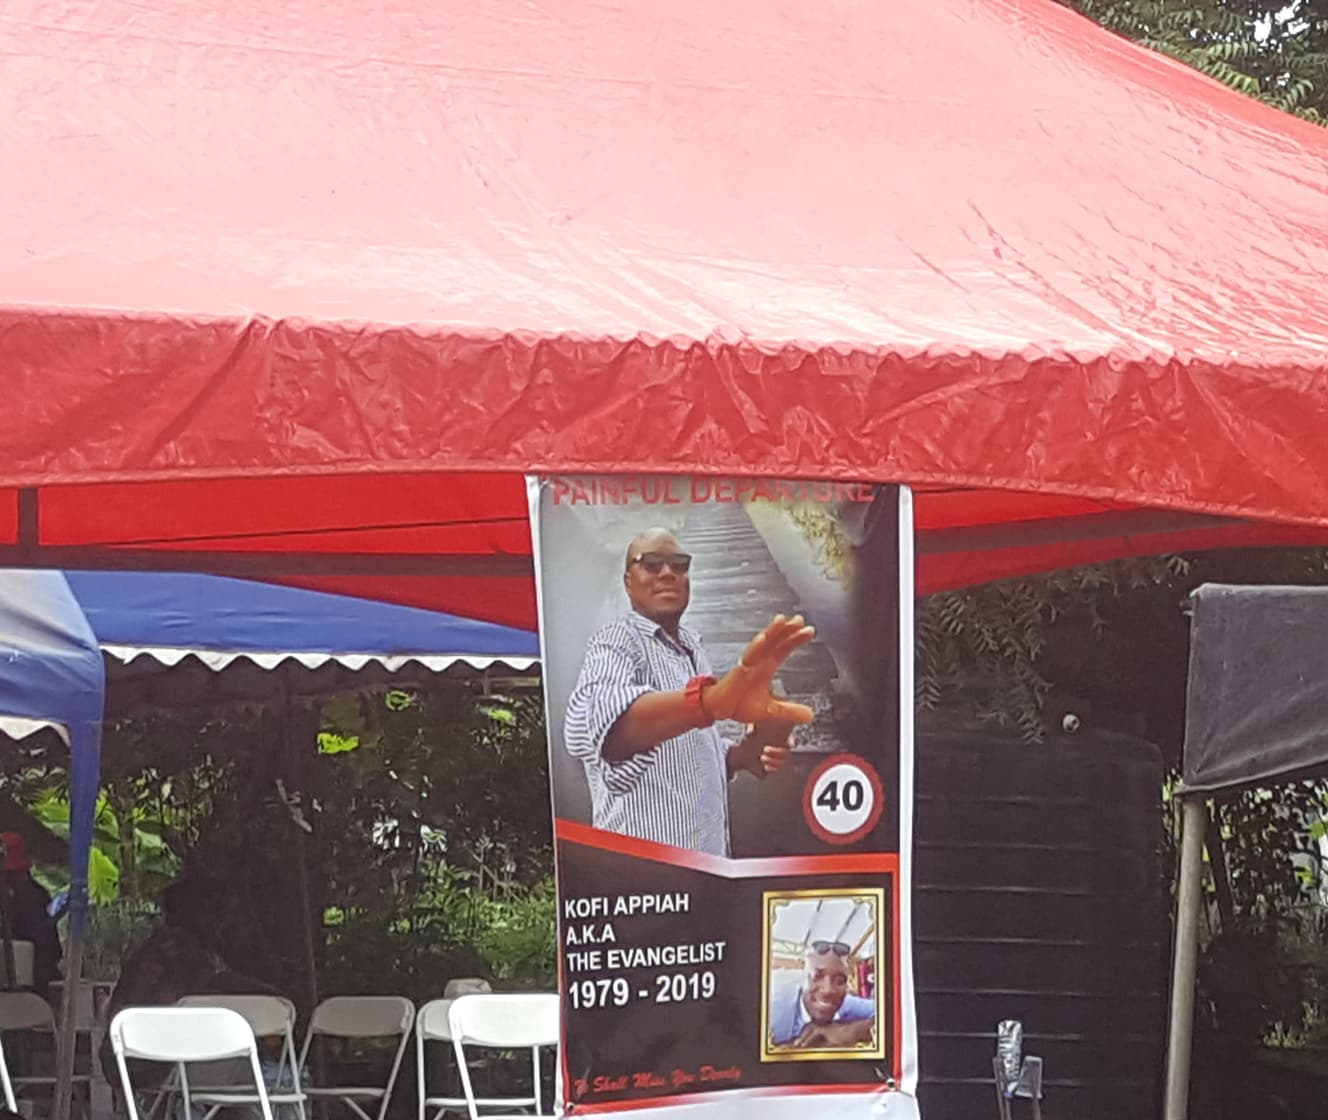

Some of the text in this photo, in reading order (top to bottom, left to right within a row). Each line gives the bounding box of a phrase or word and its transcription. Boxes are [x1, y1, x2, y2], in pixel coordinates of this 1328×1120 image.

[552, 475, 876, 506] PAINFUL DEPARTURE
[816, 780, 864, 811] 40
[565, 893, 689, 919] KOFI APPIAH
[566, 923, 616, 946] A.K.A
[567, 942, 726, 972] THE EVANGELIST
[569, 977, 629, 1009] 1979
[655, 971, 715, 1003] 2019
